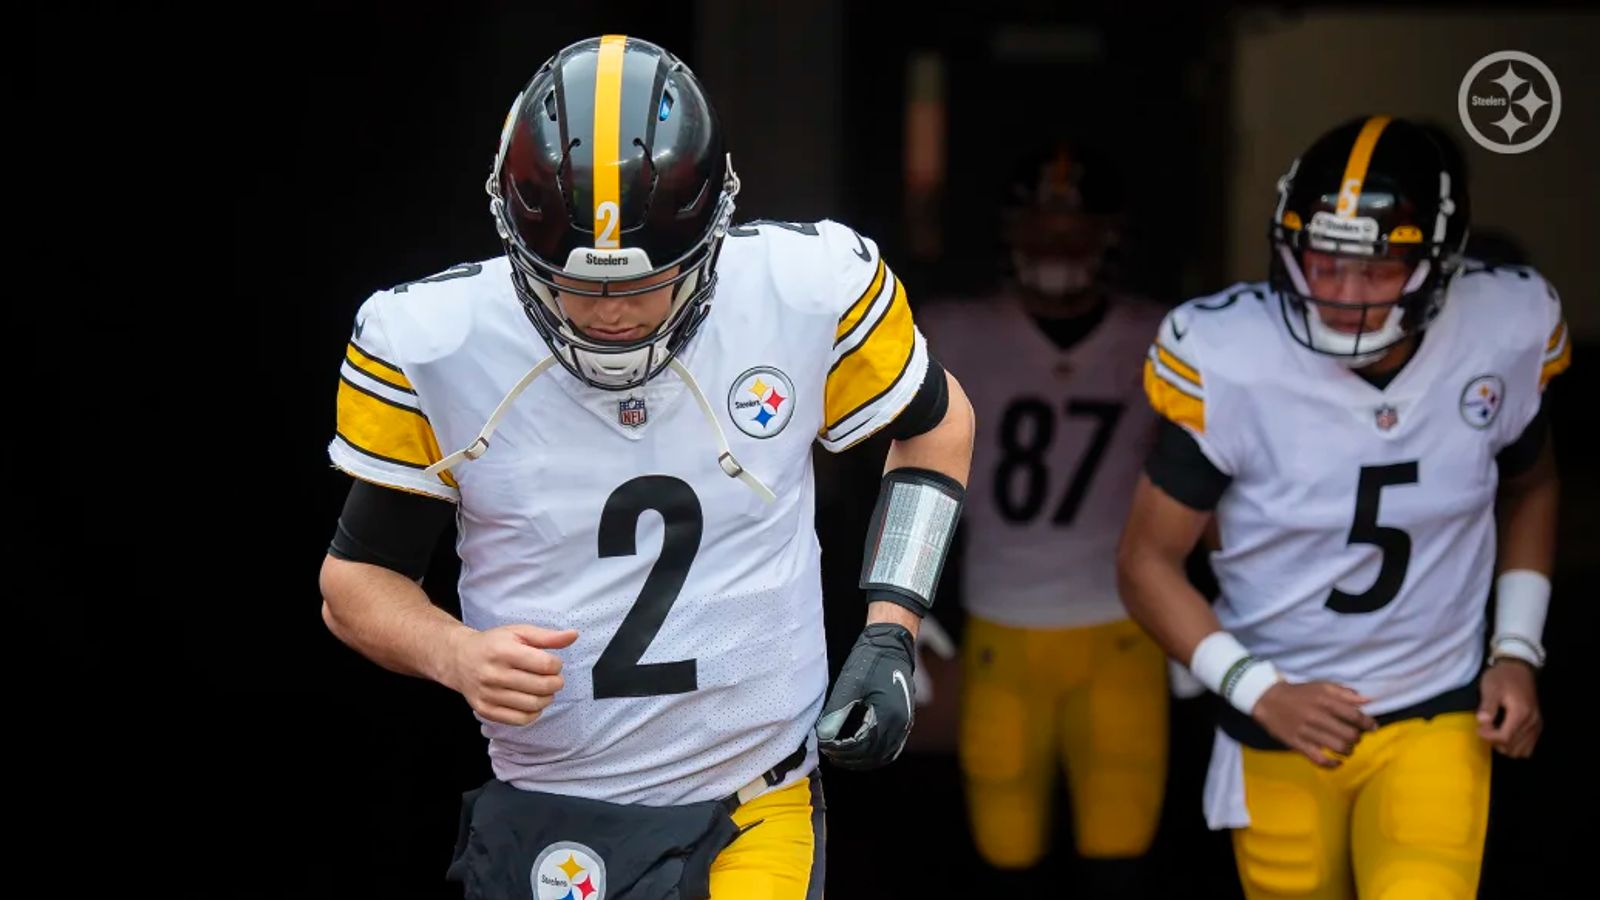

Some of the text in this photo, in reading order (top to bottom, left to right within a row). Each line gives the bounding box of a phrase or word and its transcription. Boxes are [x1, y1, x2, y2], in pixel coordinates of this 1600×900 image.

[585, 252, 629, 266] Steelers
[594, 200, 620, 248] 2
[622, 409, 646, 425] NFL
[993, 397, 1128, 527] 87
[1324, 460, 1420, 615] 5
[591, 474, 704, 700] 2
